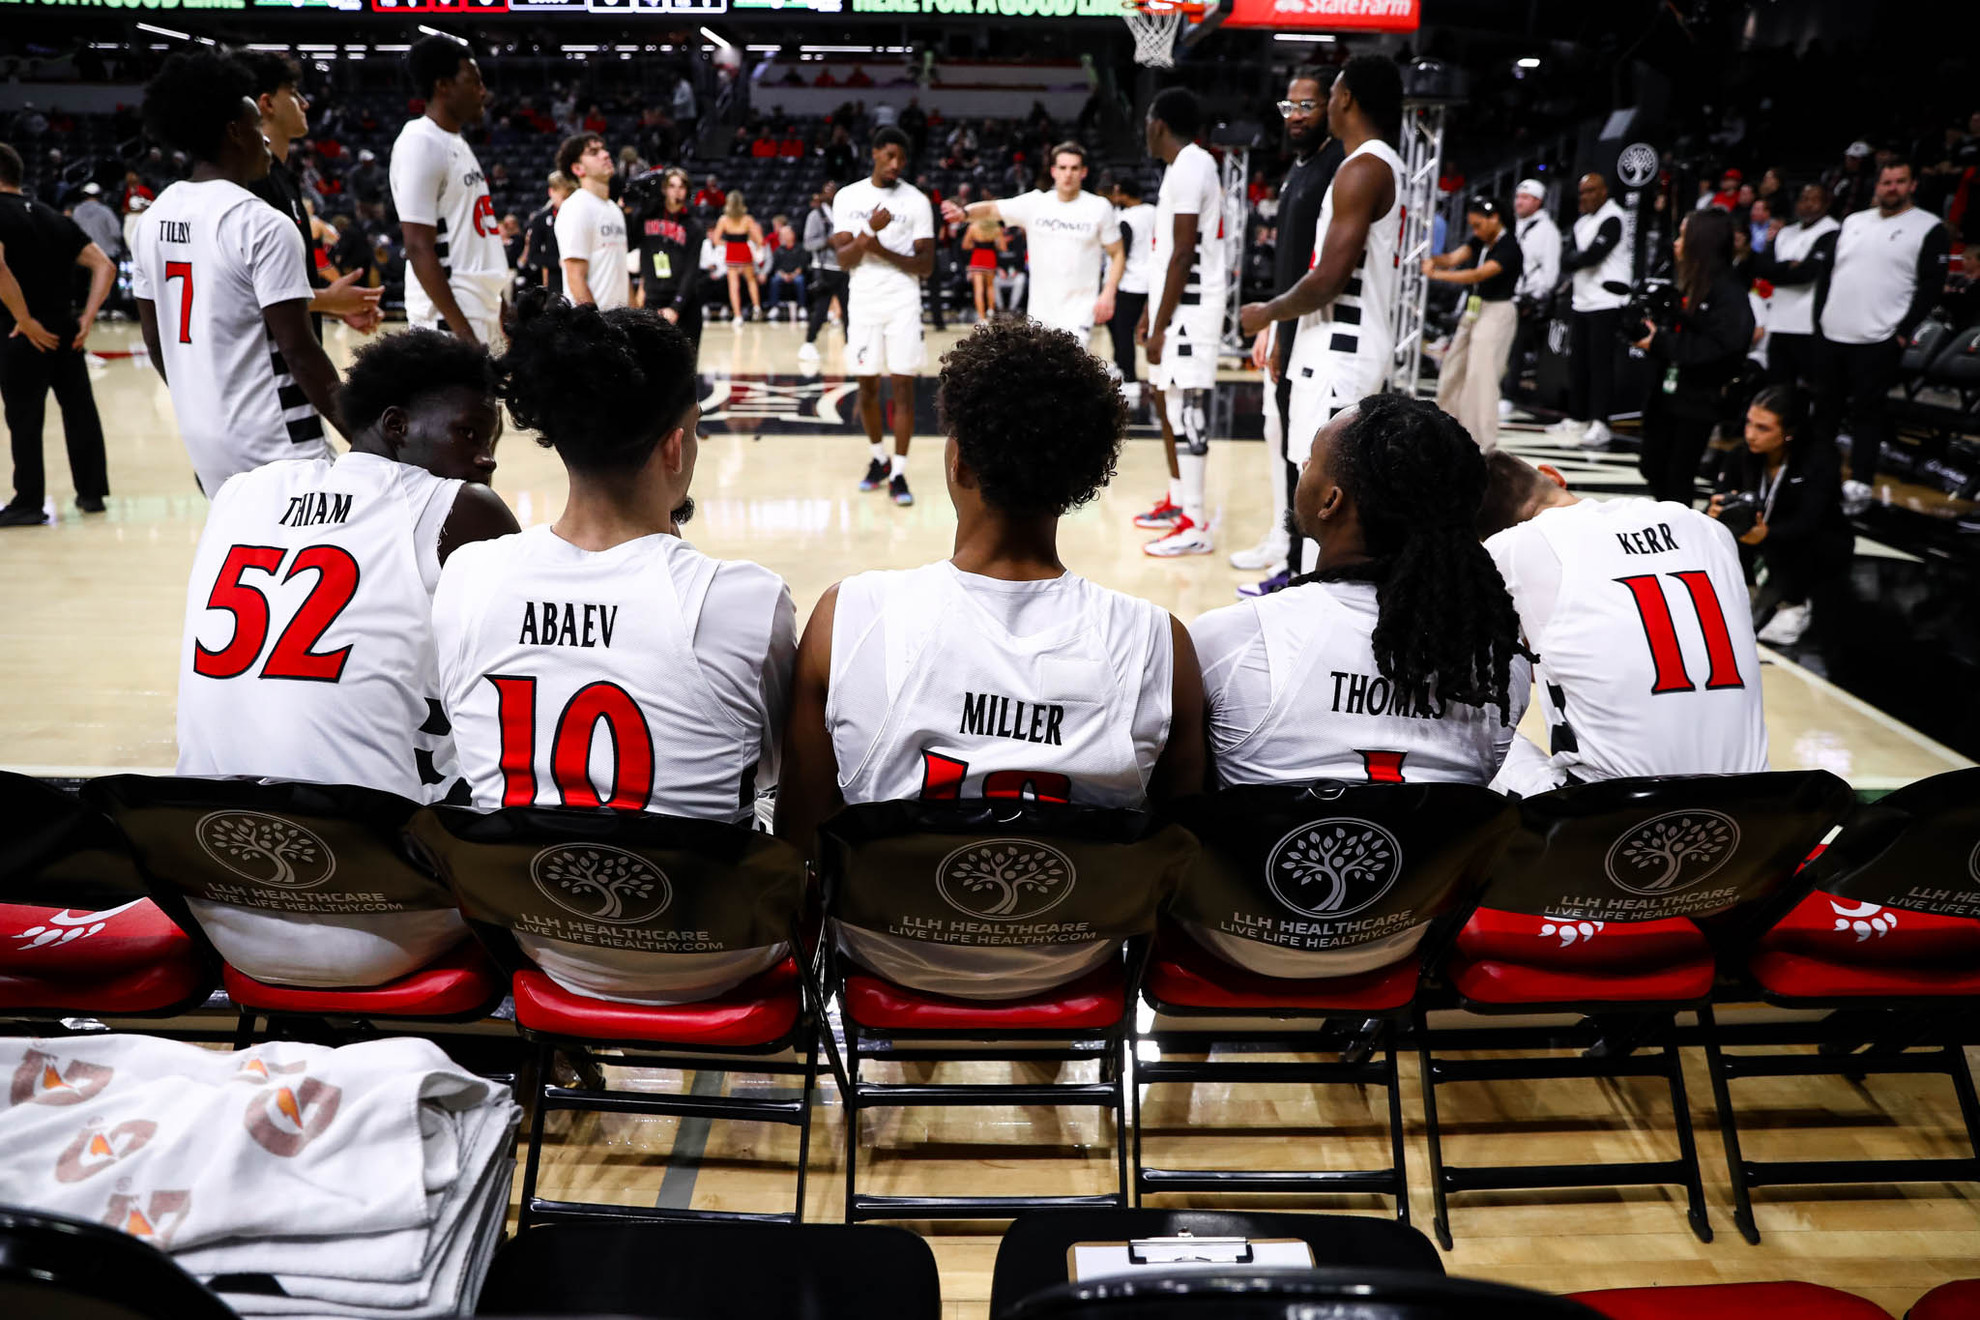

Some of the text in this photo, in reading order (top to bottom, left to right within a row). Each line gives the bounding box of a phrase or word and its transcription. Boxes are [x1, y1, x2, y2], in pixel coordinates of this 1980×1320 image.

[165, 261, 194, 344] 7
[278, 491, 353, 527] THIAM
[1615, 522, 1680, 555] KERR
[193, 543, 361, 684] 52
[518, 601, 618, 648] ABAEV
[1611, 569, 1746, 696] 11
[959, 691, 1064, 746] MILLER
[482, 673, 655, 812] 10
[205, 890, 242, 905] LIVE
[247, 897, 282, 910] LIFE
[208, 882, 387, 903] LLH HEALTHCARE
[1561, 886, 1738, 910] LLH HEALTHCARE
[1887, 895, 1928, 910] LIVE
[1929, 902, 1968, 915] LIFE
[1907, 886, 1950, 901] LLH
[521, 913, 710, 941] LLH HEALTHCARE
[903, 916, 1090, 935] LLH HEALTHCARE
[1233, 909, 1412, 936] LLH HEALTHCARE
[1544, 905, 1583, 917] LIVE
[1588, 909, 1627, 921] LIFE
[514, 921, 724, 951] LIVE LIFE HEALTHY.COM
[889, 925, 1097, 945] LIVE LIFE HEALTHY.COM
[1220, 917, 1416, 949] LIVE LIFE HEALTHY.COM
